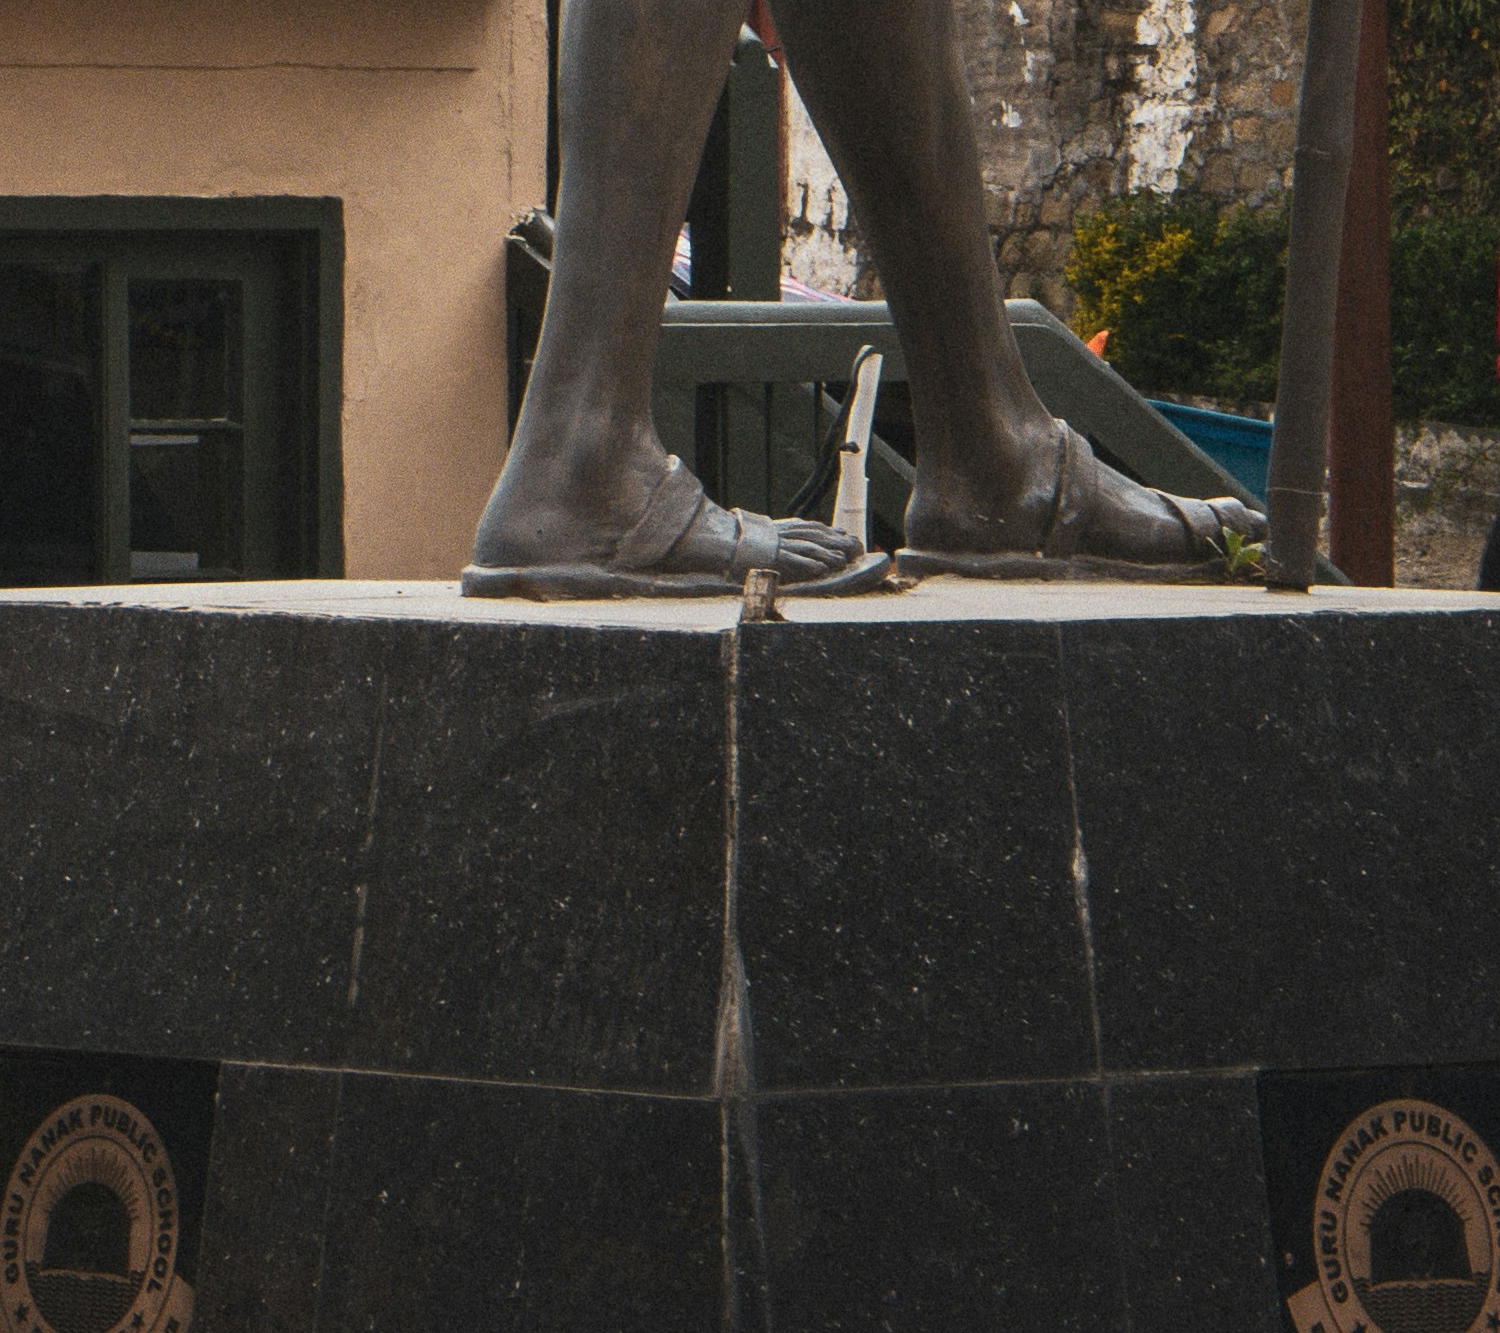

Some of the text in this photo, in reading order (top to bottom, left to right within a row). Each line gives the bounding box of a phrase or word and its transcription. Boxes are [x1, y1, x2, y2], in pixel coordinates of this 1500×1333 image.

[1324, 1117, 1389, 1201] NANAK
[1392, 1110, 1479, 1164] PUBLIC
[3, 1104, 175, 1294] GURU NANAK PUBLIC SCHOOL
[1320, 1210, 1349, 1304] GURU
